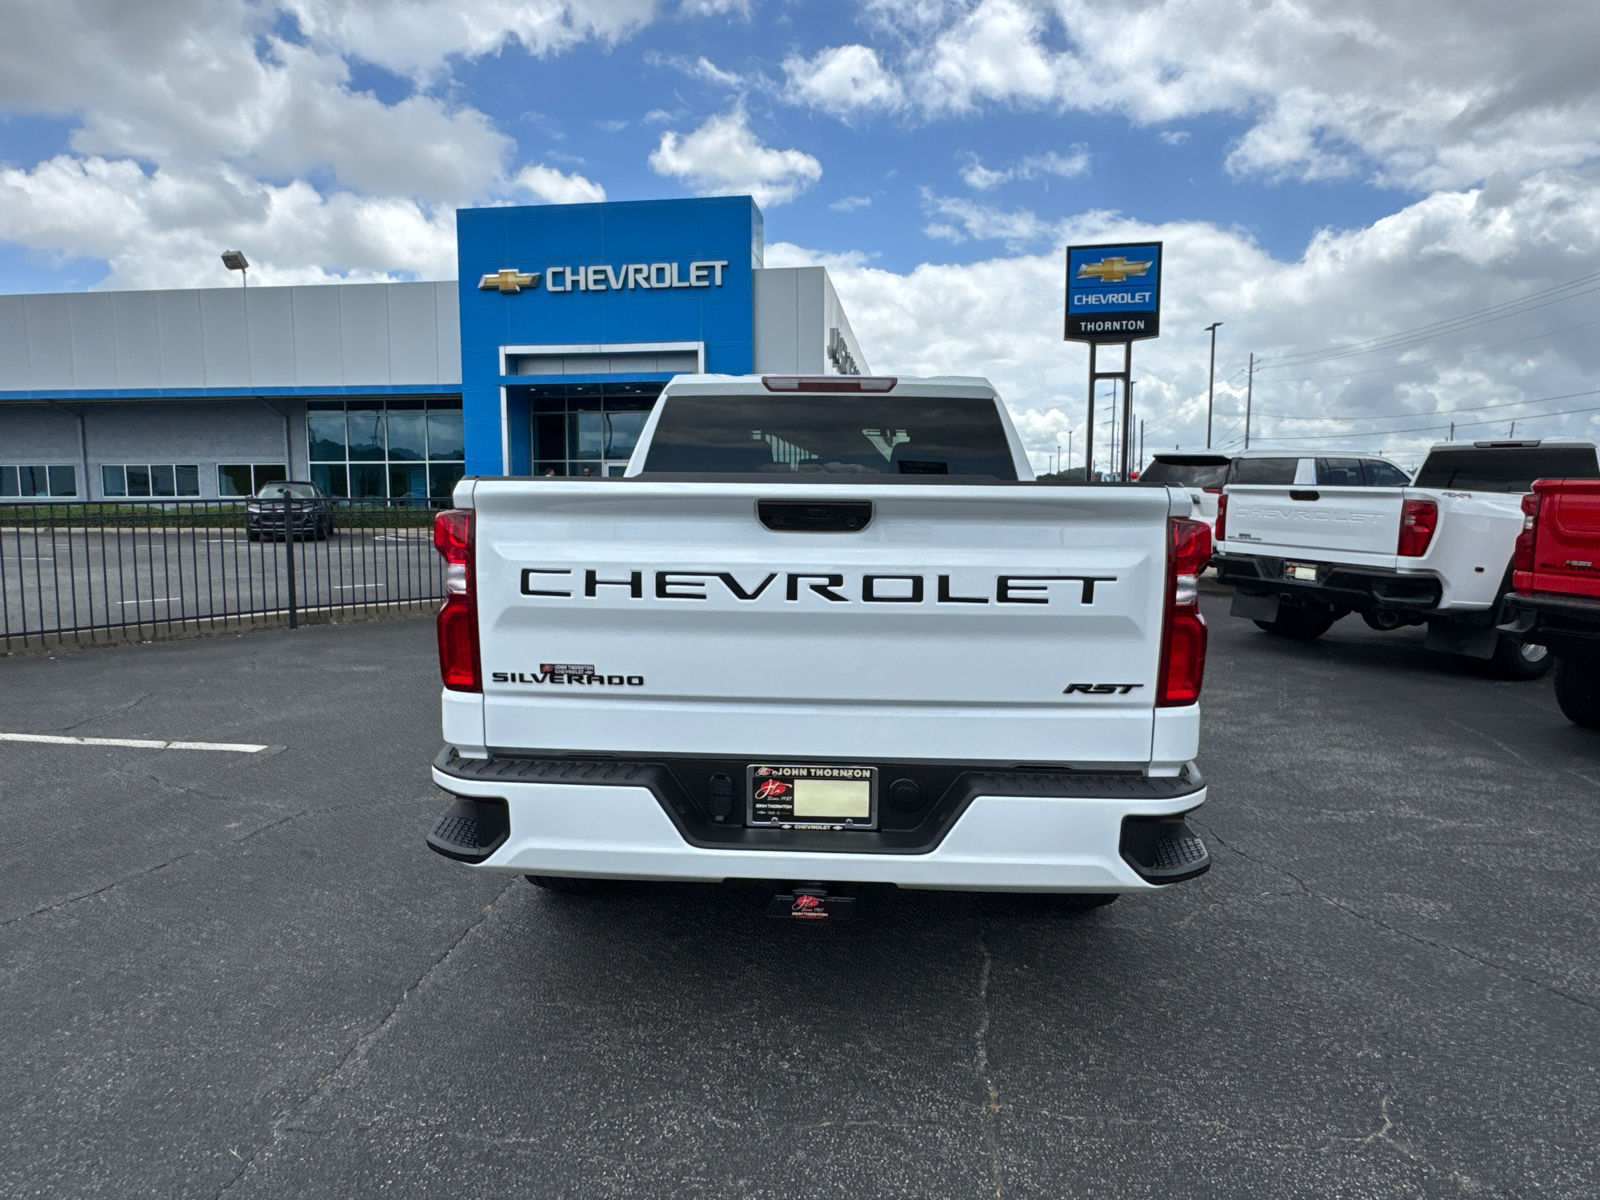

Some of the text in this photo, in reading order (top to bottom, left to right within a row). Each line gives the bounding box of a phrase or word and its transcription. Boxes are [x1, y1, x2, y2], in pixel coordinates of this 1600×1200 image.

[546, 261, 728, 292] CHEVROLET
[1074, 292, 1152, 305] CHEVROLET
[1079, 320, 1145, 332] THORNTON
[1235, 508, 1385, 524] CHEVROLET
[520, 568, 1118, 605] CHEVROLET
[492, 672, 644, 686] SILVERADO
[1062, 683, 1144, 694] RST
[778, 768, 807, 776] JOHN
[810, 769, 871, 778] THORNTON
